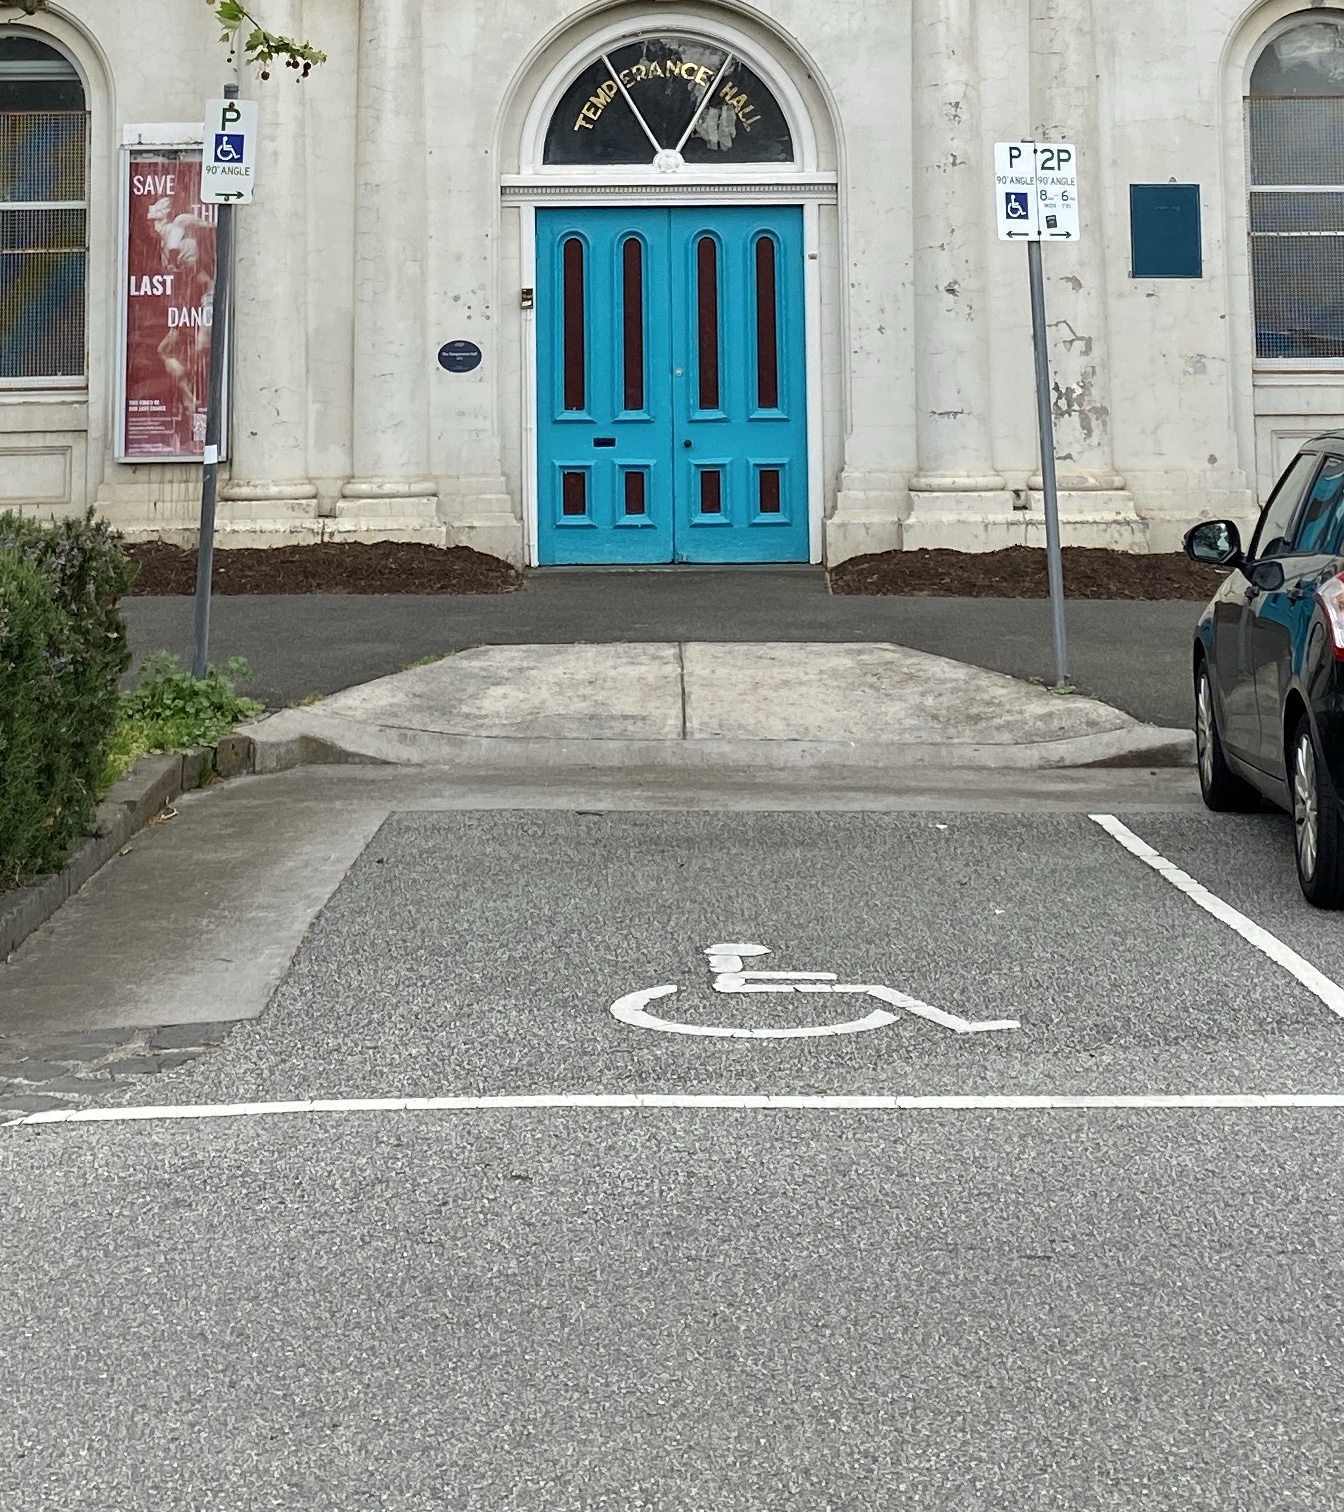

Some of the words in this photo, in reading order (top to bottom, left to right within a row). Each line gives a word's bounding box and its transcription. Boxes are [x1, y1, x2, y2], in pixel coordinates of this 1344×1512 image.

[573, 60, 714, 132] TEMPERANCE
[718, 81, 761, 133] HALL
[221, 107, 241, 131] P
[1009, 147, 1022, 169] P
[1040, 148, 1072, 171] 2P
[220, 166, 251, 177] ANGLE
[1009, 176, 1036, 186] ANGLE
[1050, 176, 1076, 187] ANGLE
[133, 174, 176, 196] SAVE
[130, 275, 174, 296] LAST
[167, 306, 214, 328] DANC
